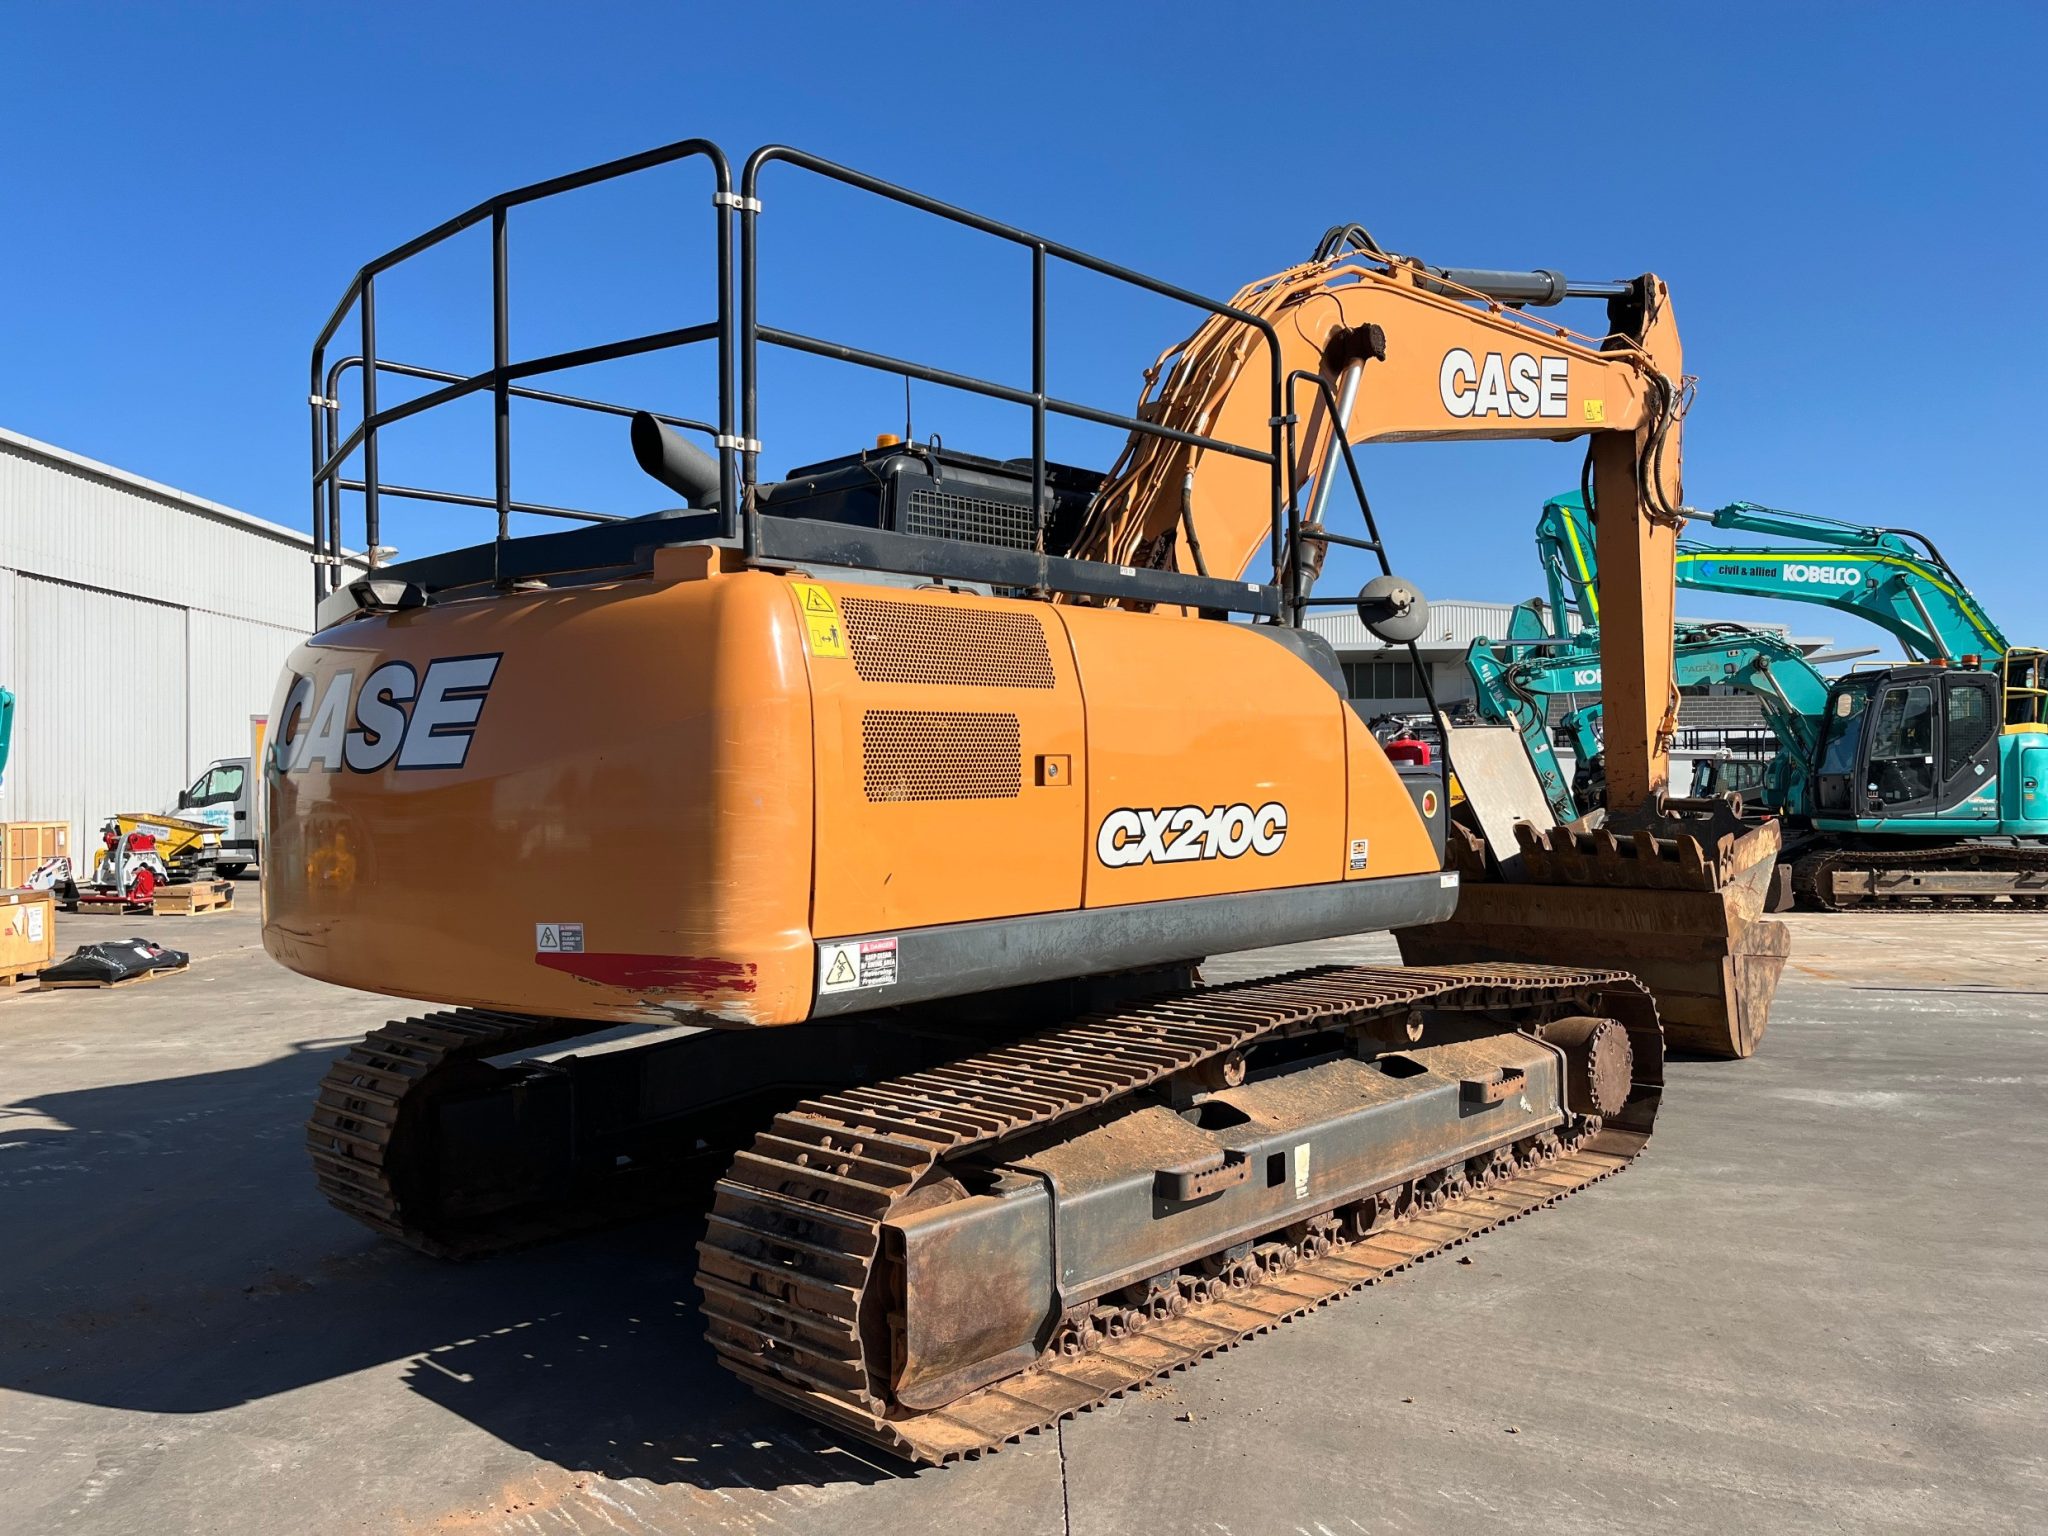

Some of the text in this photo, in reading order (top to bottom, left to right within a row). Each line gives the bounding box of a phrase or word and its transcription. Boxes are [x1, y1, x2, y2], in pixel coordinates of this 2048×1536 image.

[1439, 347, 1568, 419] CASE
[1719, 565, 1777, 577] civil & allied
[1783, 564, 1861, 585] KOBELCO
[277, 652, 504, 774] CASE
[1096, 801, 1288, 869] CX210C
